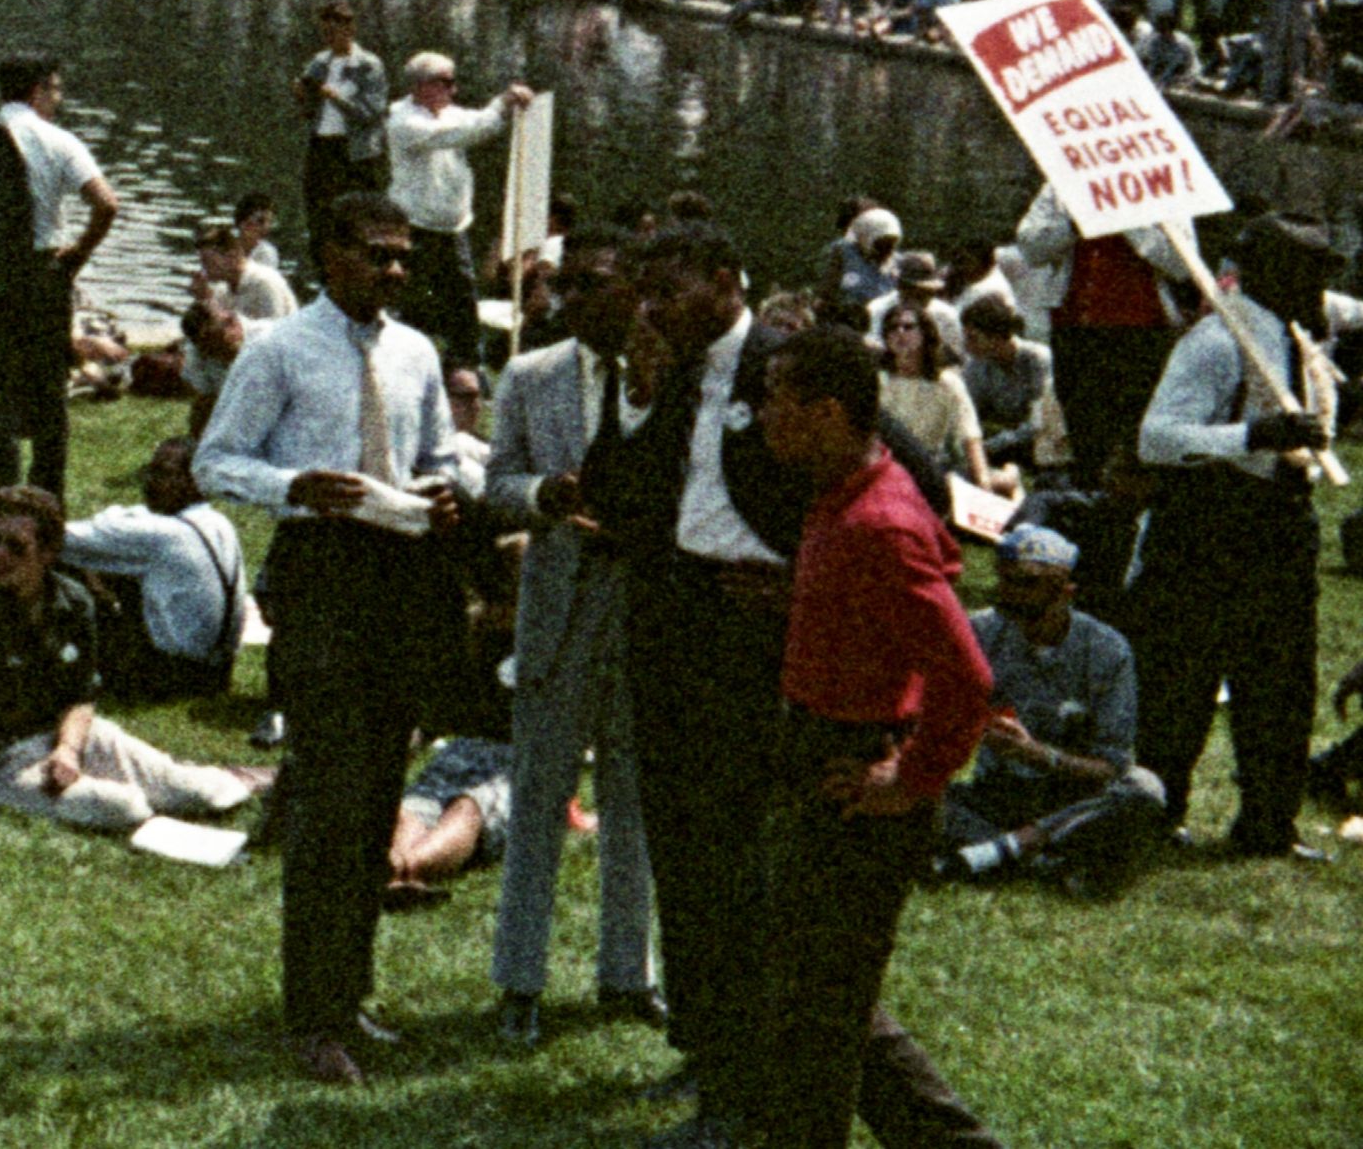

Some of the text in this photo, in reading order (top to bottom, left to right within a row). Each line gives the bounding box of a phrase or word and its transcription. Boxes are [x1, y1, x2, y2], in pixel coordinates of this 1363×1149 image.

[1007, 5, 1062, 52] WE
[1000, 21, 1116, 103] DEMAND
[1042, 98, 1152, 137] EQUAL
[1061, 128, 1179, 171] RIGHTS
[1088, 158, 1196, 212] NOW!
